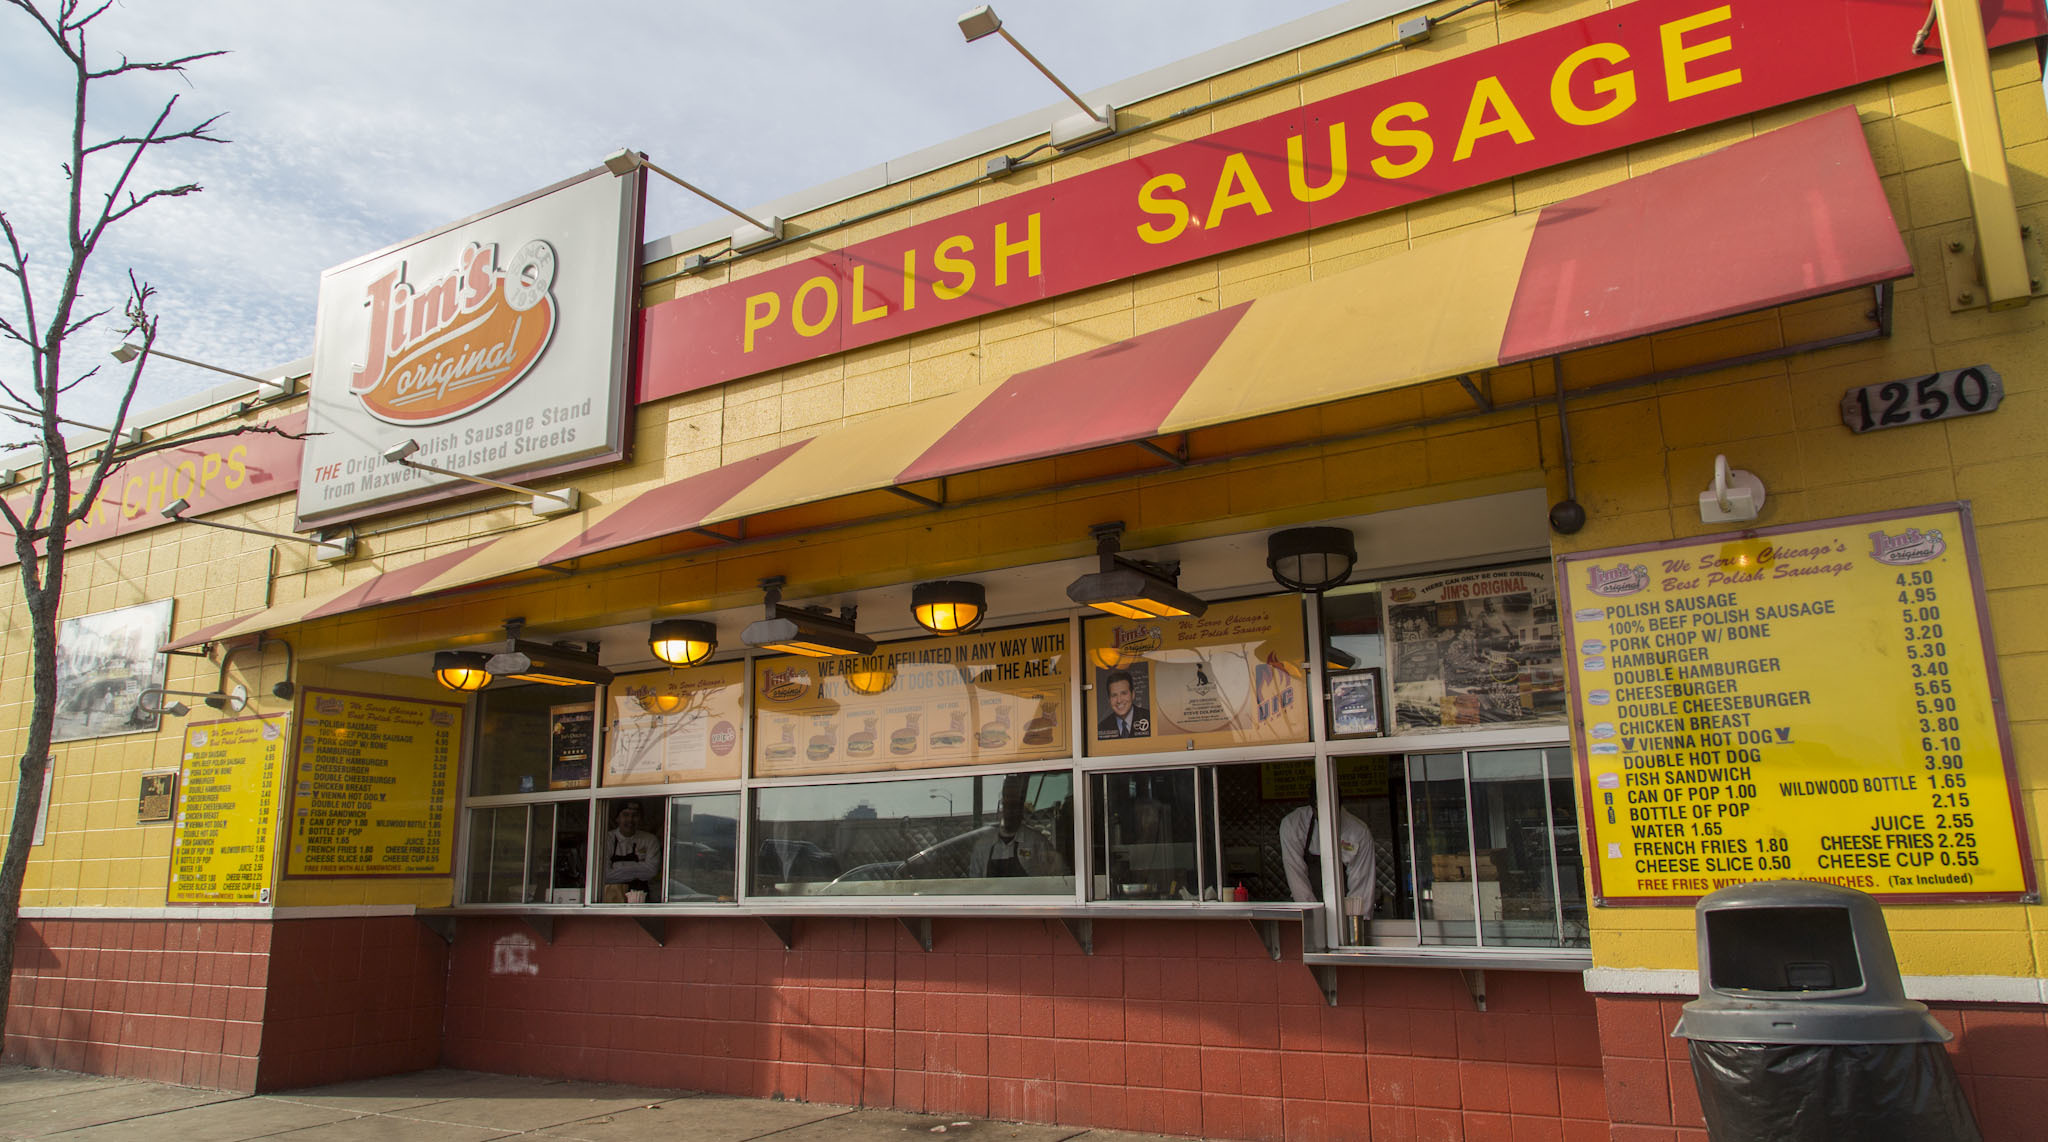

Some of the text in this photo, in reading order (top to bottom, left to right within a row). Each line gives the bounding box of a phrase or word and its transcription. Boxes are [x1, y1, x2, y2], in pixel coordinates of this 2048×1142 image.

[743, 5, 1742, 354] POLISH SAUSAGE
[350, 242, 498, 394] Jim's
[396, 316, 522, 400] original
[1856, 367, 1988, 431] 1250
[314, 462, 342, 484] THE
[410, 433, 458, 459] olish
[465, 415, 534, 445] Sausage
[542, 399, 592, 427] Stand
[324, 482, 355, 500] from
[446, 442, 509, 471] Halsted
[514, 427, 577, 455] Streets
[122, 444, 247, 519] CHOPS
[1869, 528, 1922, 557] Jim's
[1890, 545, 1935, 560] original
[1662, 559, 1691, 574] We
[1756, 539, 1848, 564] Chicago's
[1421, 582, 1444, 594] THERE
[1461, 574, 1480, 583] ONLY
[1510, 571, 1544, 580] ORIGINAL
[1440, 577, 1528, 601] JIM'S ORIGINAL
[1587, 563, 1630, 590] Jim's
[1600, 576, 1642, 593] original
[1662, 561, 1854, 592] Best Polish Sausage
[1606, 570, 1933, 620] POLISH SAUSAGE 4.50
[1178, 610, 1270, 630] We Serve Chicago's
[1608, 587, 1936, 636] 100% BEEF POLISH SAUSAGE 4.95
[1112, 624, 1150, 649] Jim's
[1178, 624, 1272, 641] Best Polish Sausage
[1610, 606, 1940, 652] PORK CHOP W/ BONE 5.00
[818, 634, 1065, 678] WE ARE NOT AFFILIATED IN ANY WAY WITH
[1612, 624, 1943, 669] HAMBURGER 3.20
[1614, 642, 1946, 685] DOUBLE HAMBURGER 5.30
[817, 682, 840, 699] ANY
[908, 671, 934, 690] DOG
[937, 666, 976, 688] STAND
[980, 665, 993, 683] IN
[996, 662, 1020, 681] THE
[1023, 658, 1062, 678] AREA.
[1616, 662, 1949, 702] CHEESEBURGER 3.40
[1618, 679, 1952, 719] DOUBLE CHEESEBURGER 5.65
[1619, 697, 1956, 736] CHICKEN BREAST 5.90
[1639, 717, 1959, 751] VIENNA HOT DOG 3.80
[1623, 737, 1961, 770] DOUBLE HOT DOG 6.10
[1626, 755, 1963, 787] FISH SANDWICH 3.90
[321, 791, 378, 801] VIENNA HOT DOG
[1627, 784, 1757, 804] CAN OF POP 1.00
[1779, 773, 1967, 797] WILDWOOD BOTTLE 1.65
[312, 801, 339, 809] DOUBLE
[329, 810, 366, 818] SANDWICH
[1630, 793, 1970, 821] BOTTLE OF POP 2.15
[308, 827, 363, 836] BOTTLE POP
[309, 818, 352, 827] CAN POP
[1632, 822, 1723, 839] WATER 1.65
[1871, 813, 1974, 831] JUICE 2.55
[308, 836, 350, 844] WATER 1.65
[1634, 837, 1789, 856] FRENCH FRIES 1.80
[1821, 832, 1976, 850] CHEESE FRIES 2.25
[305, 855, 357, 863] CHEESE SLICE
[1635, 855, 1791, 873] CHEESE SLICE 0.50
[1818, 851, 1979, 869] CHEESE CUP 0.55
[1638, 879, 1668, 891] FREE
[1672, 878, 1709, 890] FRIES
[1781, 875, 1880, 888] WICHES.
[1888, 875, 1913, 888] (Tax
[1917, 873, 1973, 886] Included)
